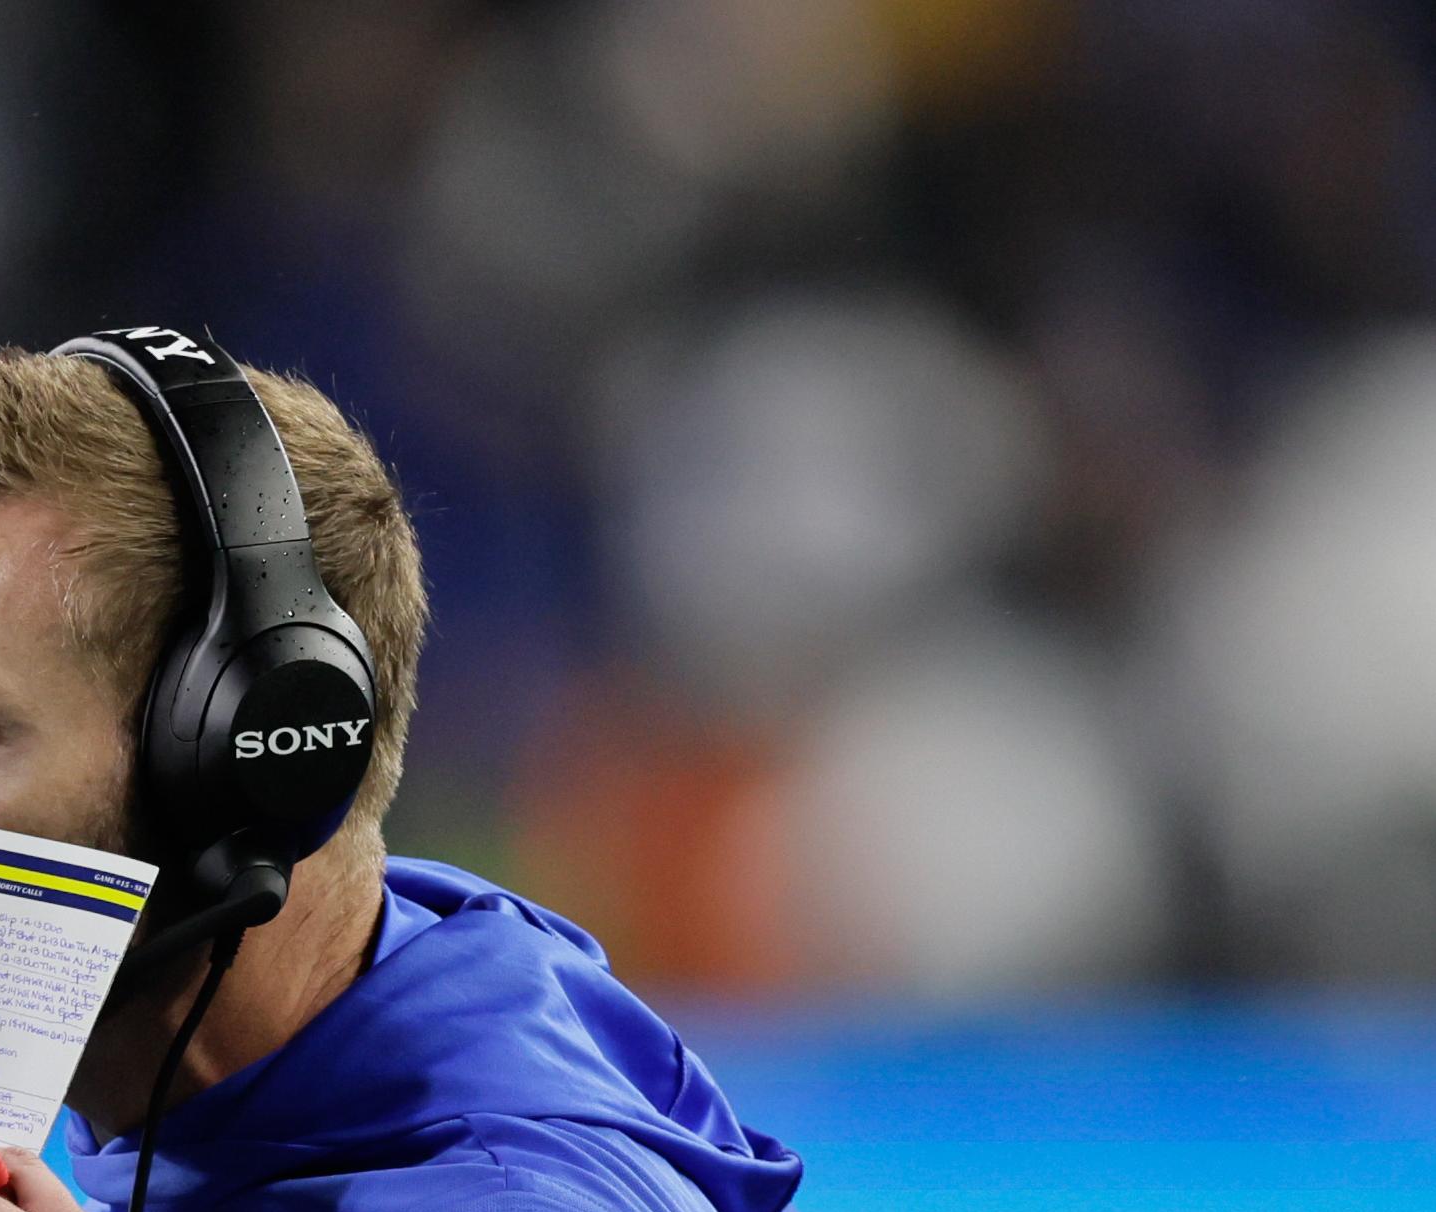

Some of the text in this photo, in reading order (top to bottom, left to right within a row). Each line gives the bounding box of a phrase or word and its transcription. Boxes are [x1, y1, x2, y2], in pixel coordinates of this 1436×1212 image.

[92, 326, 216, 365] NY
[235, 718, 370, 760] SONY
[22, 888, 43, 897] CALLS
